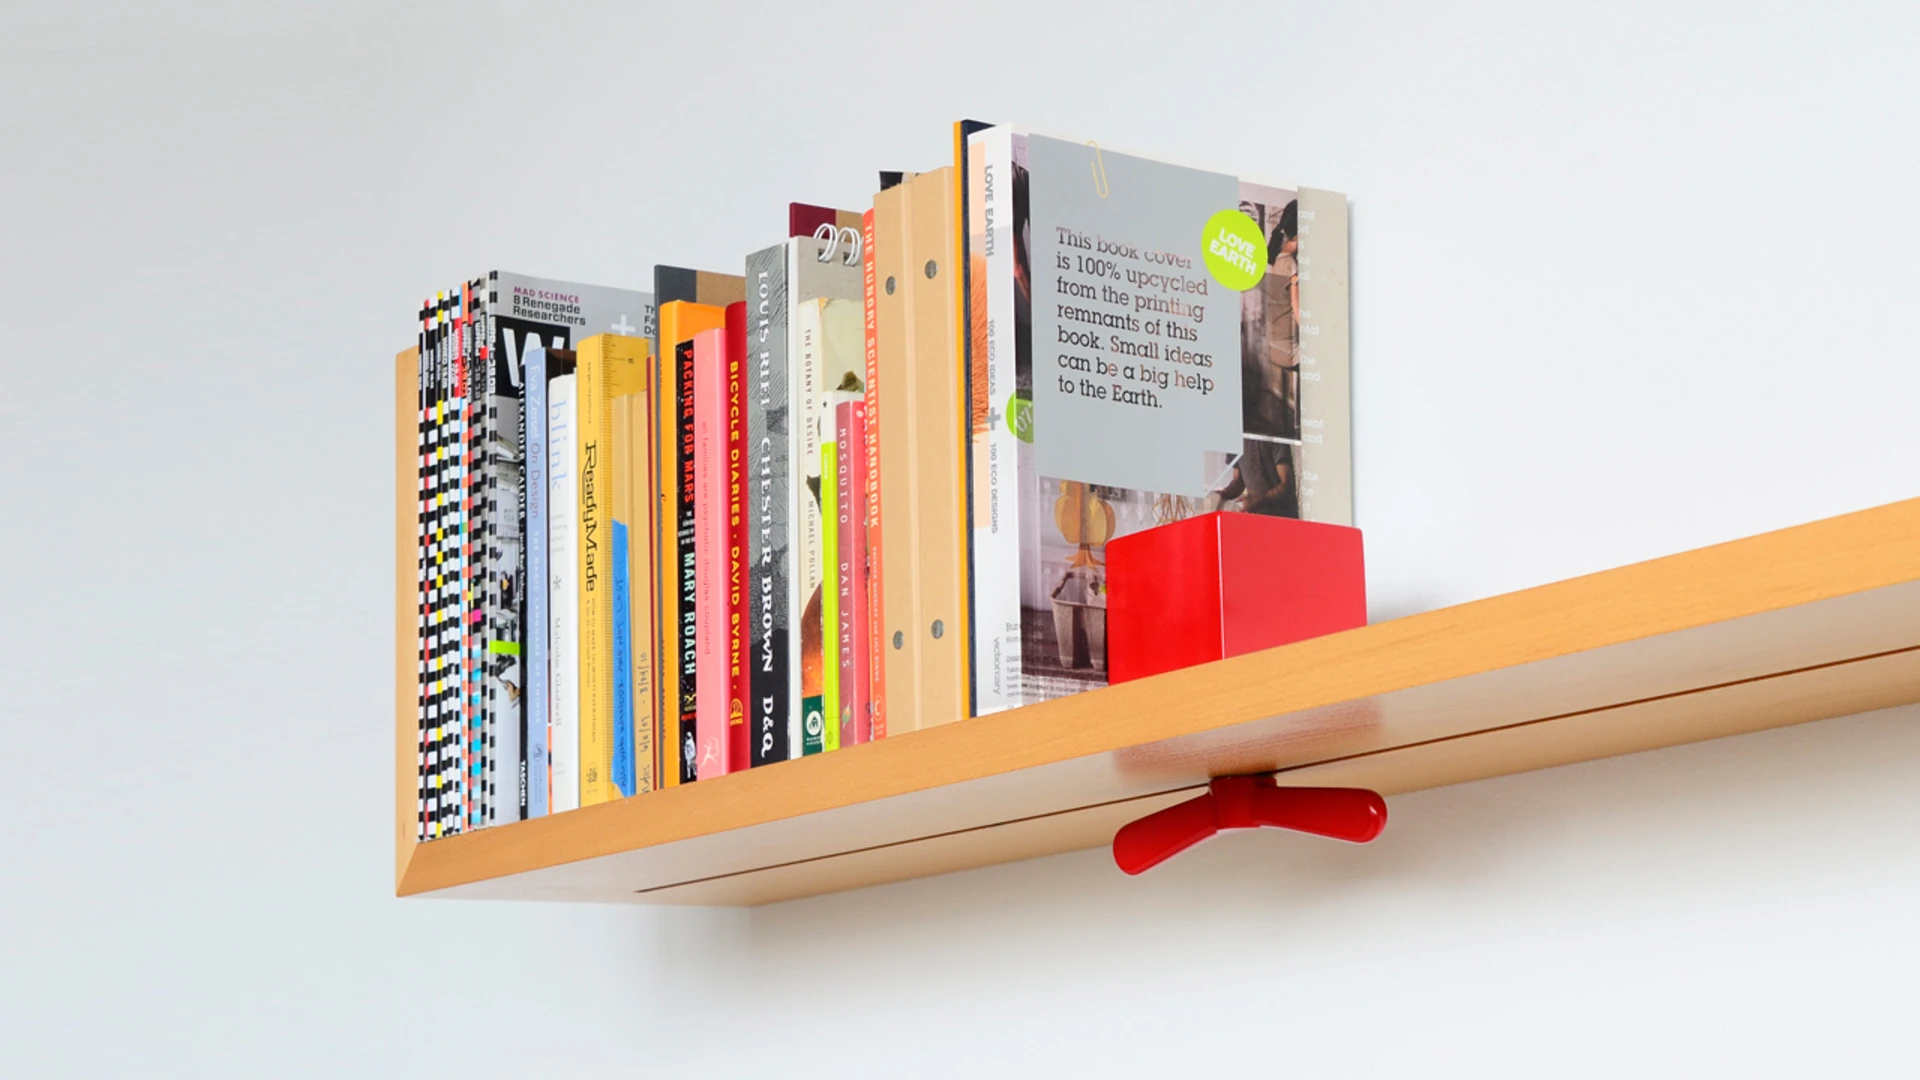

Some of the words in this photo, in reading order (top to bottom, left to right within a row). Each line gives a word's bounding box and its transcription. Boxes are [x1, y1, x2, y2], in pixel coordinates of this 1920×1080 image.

[984, 164, 994, 203] LOVE
[865, 222, 873, 255] THE
[985, 207, 995, 258] EARTH
[1056, 226, 1092, 250] This
[1096, 236, 1140, 260] book
[1144, 250, 1192, 269] cover
[1219, 228, 1256, 258] LOVE
[1056, 251, 1071, 270] is
[1077, 255, 1121, 280] 100%
[1126, 269, 1209, 296] upcycled
[1209, 239, 1257, 276] EARTH
[513, 286, 536, 298] MAD
[538, 290, 580, 304] SCIENCE
[513, 295, 521, 305] 8
[522, 296, 580, 314] Renegade
[513, 305, 586, 326] Researchers
[758, 271, 770, 344] LOUIS
[865, 260, 875, 330] HUNGRY
[1056, 276, 1097, 300] from
[1102, 285, 1129, 306] the
[1134, 294, 1205, 323] printing
[804, 328, 812, 348] THE
[988, 318, 996, 337] 100
[1056, 303, 1140, 332] remnants
[1144, 318, 1162, 336] of
[1166, 320, 1198, 342] this
[988, 340, 996, 361] ECO
[1057, 324, 1105, 350] book.
[1110, 335, 1160, 360] Small
[1164, 345, 1213, 368] ideas
[529, 364, 541, 392] Eva
[683, 348, 694, 418] PACKING
[758, 351, 770, 411] RIEL
[804, 353, 813, 394] BOTANY
[866, 336, 877, 426] SCIENTIST
[989, 363, 997, 397] IDEAS
[1057, 353, 1091, 373] can
[1096, 357, 1118, 377] be
[1123, 365, 1135, 380] a
[1140, 364, 1170, 389] big
[1174, 369, 1214, 395] help
[1058, 375, 1075, 394] to
[1080, 379, 1107, 400] the
[1112, 384, 1163, 409] Earth.
[530, 395, 541, 439] Zeisel
[730, 360, 739, 442] BICYCLE
[805, 399, 813, 412] OF
[530, 443, 542, 463] On
[550, 400, 568, 492] blink
[684, 423, 694, 455] FOR
[806, 417, 814, 457] DESIRE
[990, 442, 998, 461] 100
[518, 464, 526, 520] CALDER
[529, 469, 542, 519] Design
[684, 460, 695, 504] MARS
[731, 448, 740, 527] DIARIES
[839, 427, 849, 524] MOSQUITO
[868, 433, 879, 528] HANDBOOK
[990, 464, 998, 486] ECO
[582, 439, 598, 593] ReadyMade
[761, 437, 773, 568] CHESTER
[807, 500, 815, 545] MICHAEL
[990, 488, 998, 535] DESIGNS
[702, 502, 710, 555] psychotic
[684, 552, 695, 603] MARY
[702, 558, 711, 602] douglas
[731, 546, 740, 606] DAVID
[808, 549, 816, 590] POLLAN
[840, 562, 849, 597] DAN
[685, 610, 696, 675] ROACH
[703, 604, 711, 656] coupland
[732, 612, 740, 678] BYRNE
[761, 575, 773, 673] BROWN
[841, 610, 851, 669] JAMES
[992, 636, 1001, 696] victionary
[554, 673, 562, 727] Gladwell
[761, 694, 774, 759] D&Q
